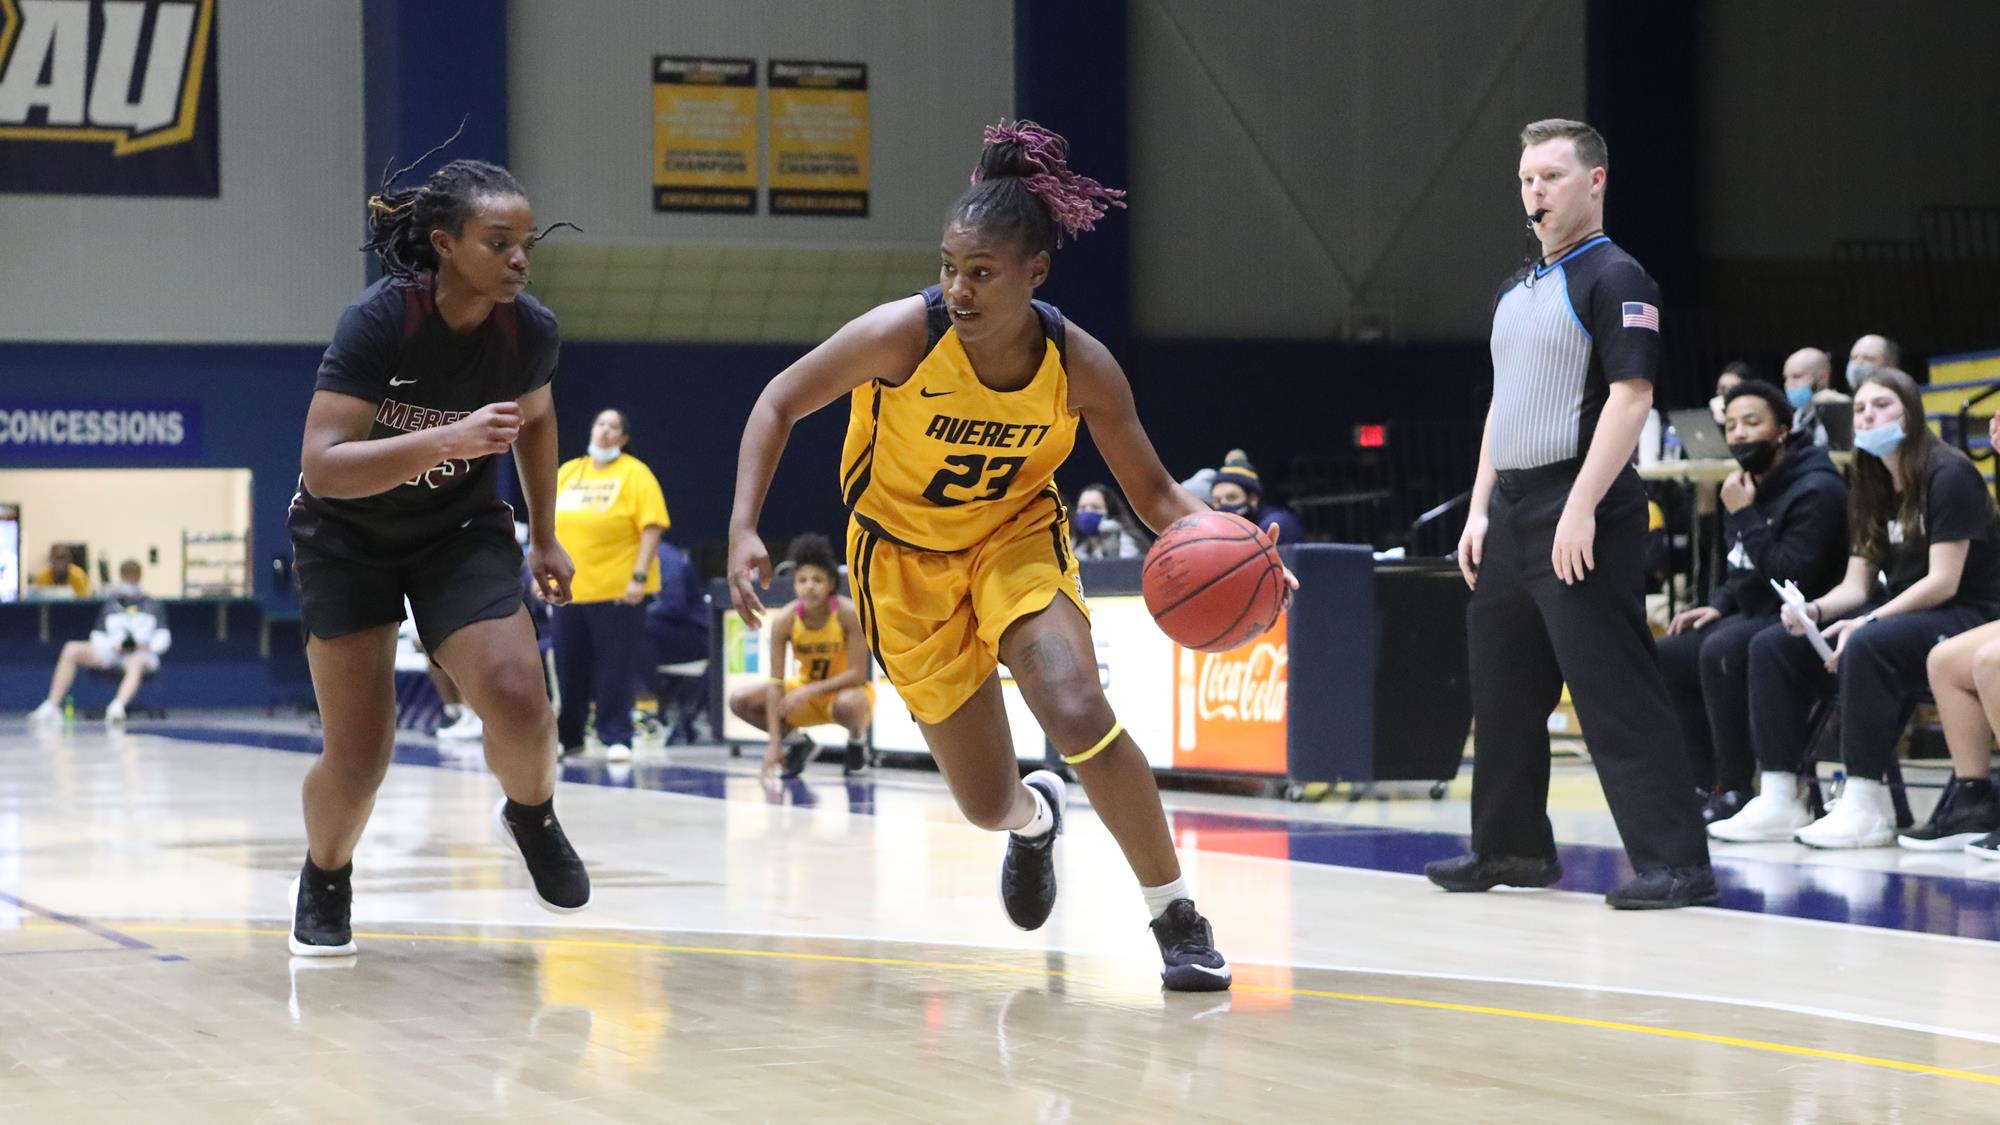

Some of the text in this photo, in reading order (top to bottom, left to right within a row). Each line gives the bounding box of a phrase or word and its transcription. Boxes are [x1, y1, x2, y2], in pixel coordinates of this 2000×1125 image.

[0, 410, 184, 445] CONCESSIONS
[925, 414, 1051, 448] AVERETT
[922, 454, 1028, 507] 23
